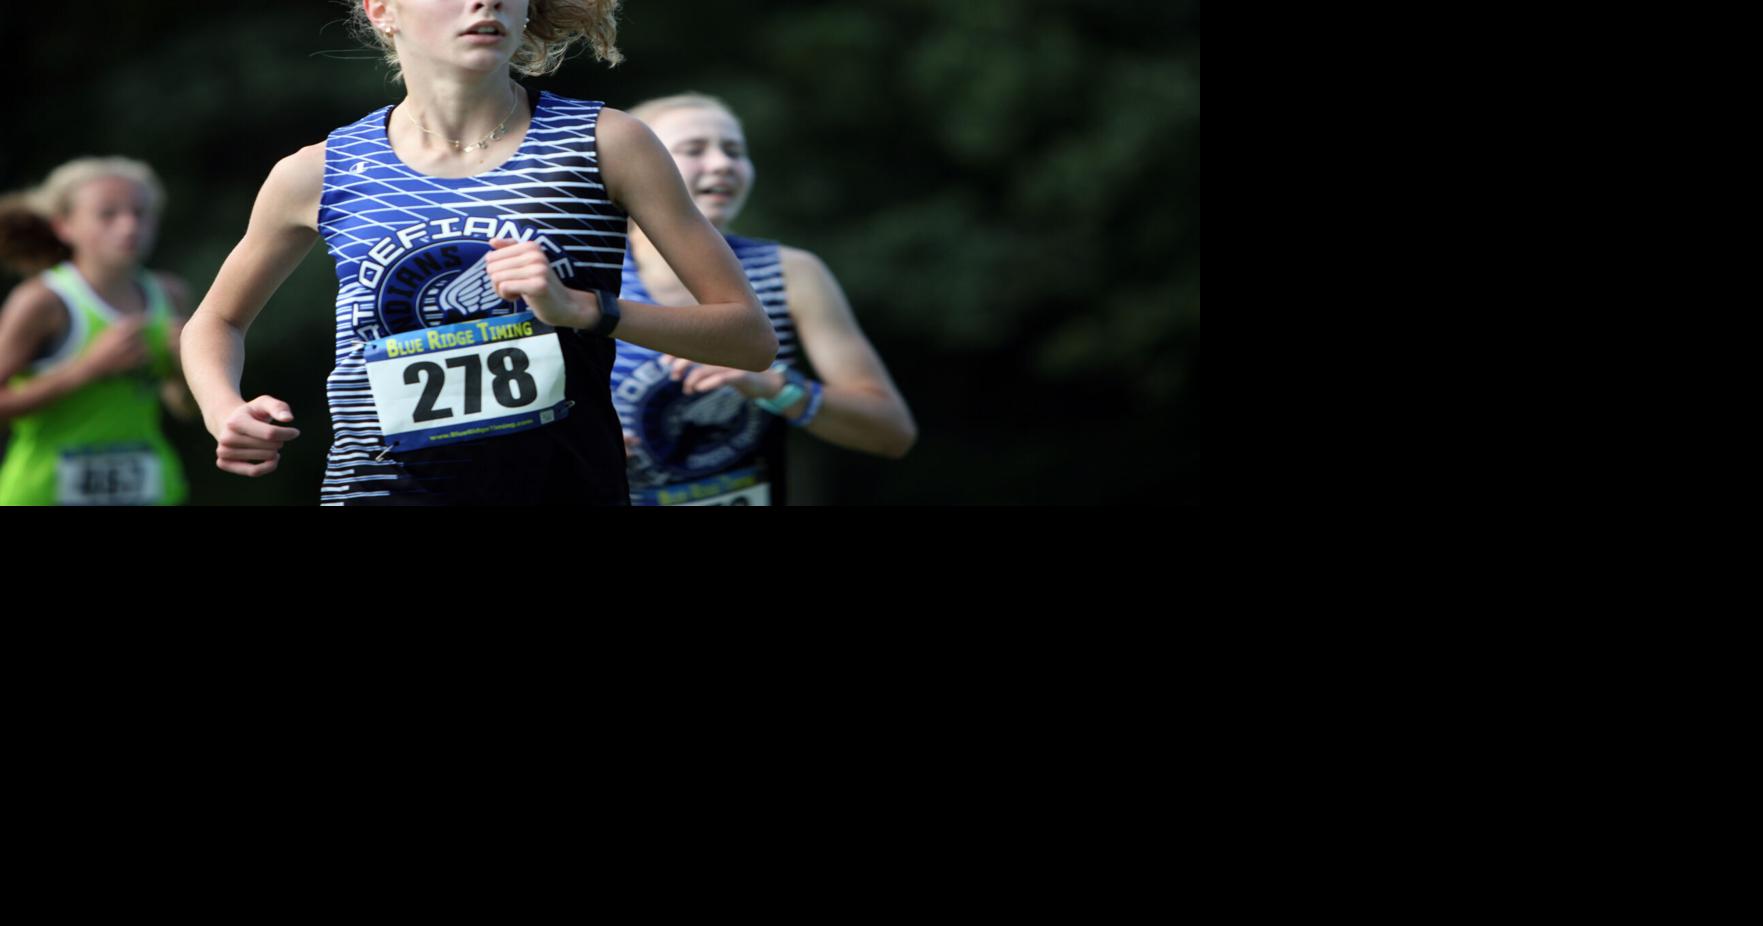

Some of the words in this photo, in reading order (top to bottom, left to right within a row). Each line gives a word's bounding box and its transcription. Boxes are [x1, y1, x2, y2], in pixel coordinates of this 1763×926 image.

[385, 245, 462, 333] NDIANS
[385, 338, 424, 358] BLUE
[426, 329, 474, 353] RIDGE
[477, 321, 533, 342] TIMING
[402, 346, 538, 424] 278
